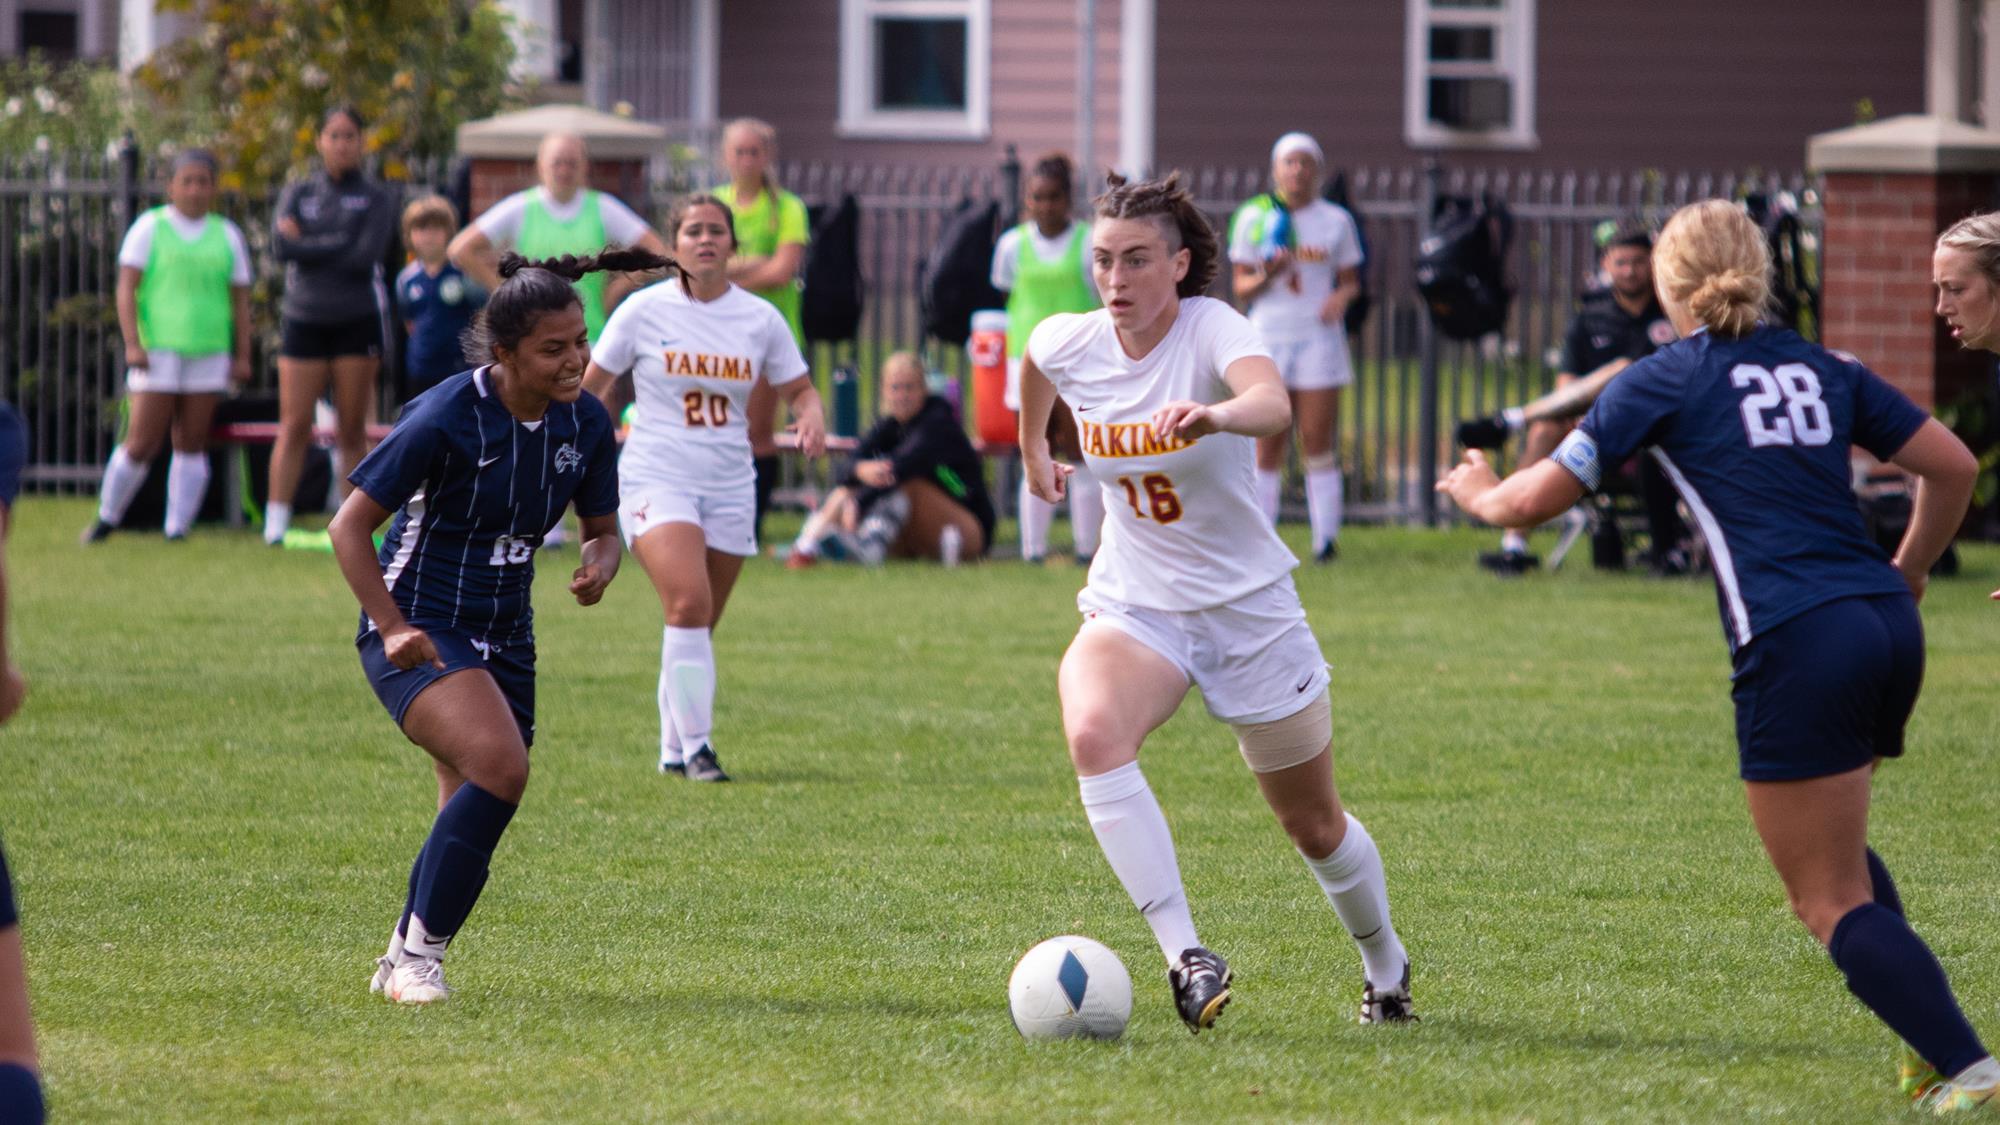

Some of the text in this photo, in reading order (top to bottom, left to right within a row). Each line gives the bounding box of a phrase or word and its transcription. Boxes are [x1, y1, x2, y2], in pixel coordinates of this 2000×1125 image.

[664, 351, 752, 381] YAKIMA
[683, 390, 729, 427] 20
[1729, 362, 1833, 447] 28
[1117, 472, 1184, 525] 16
